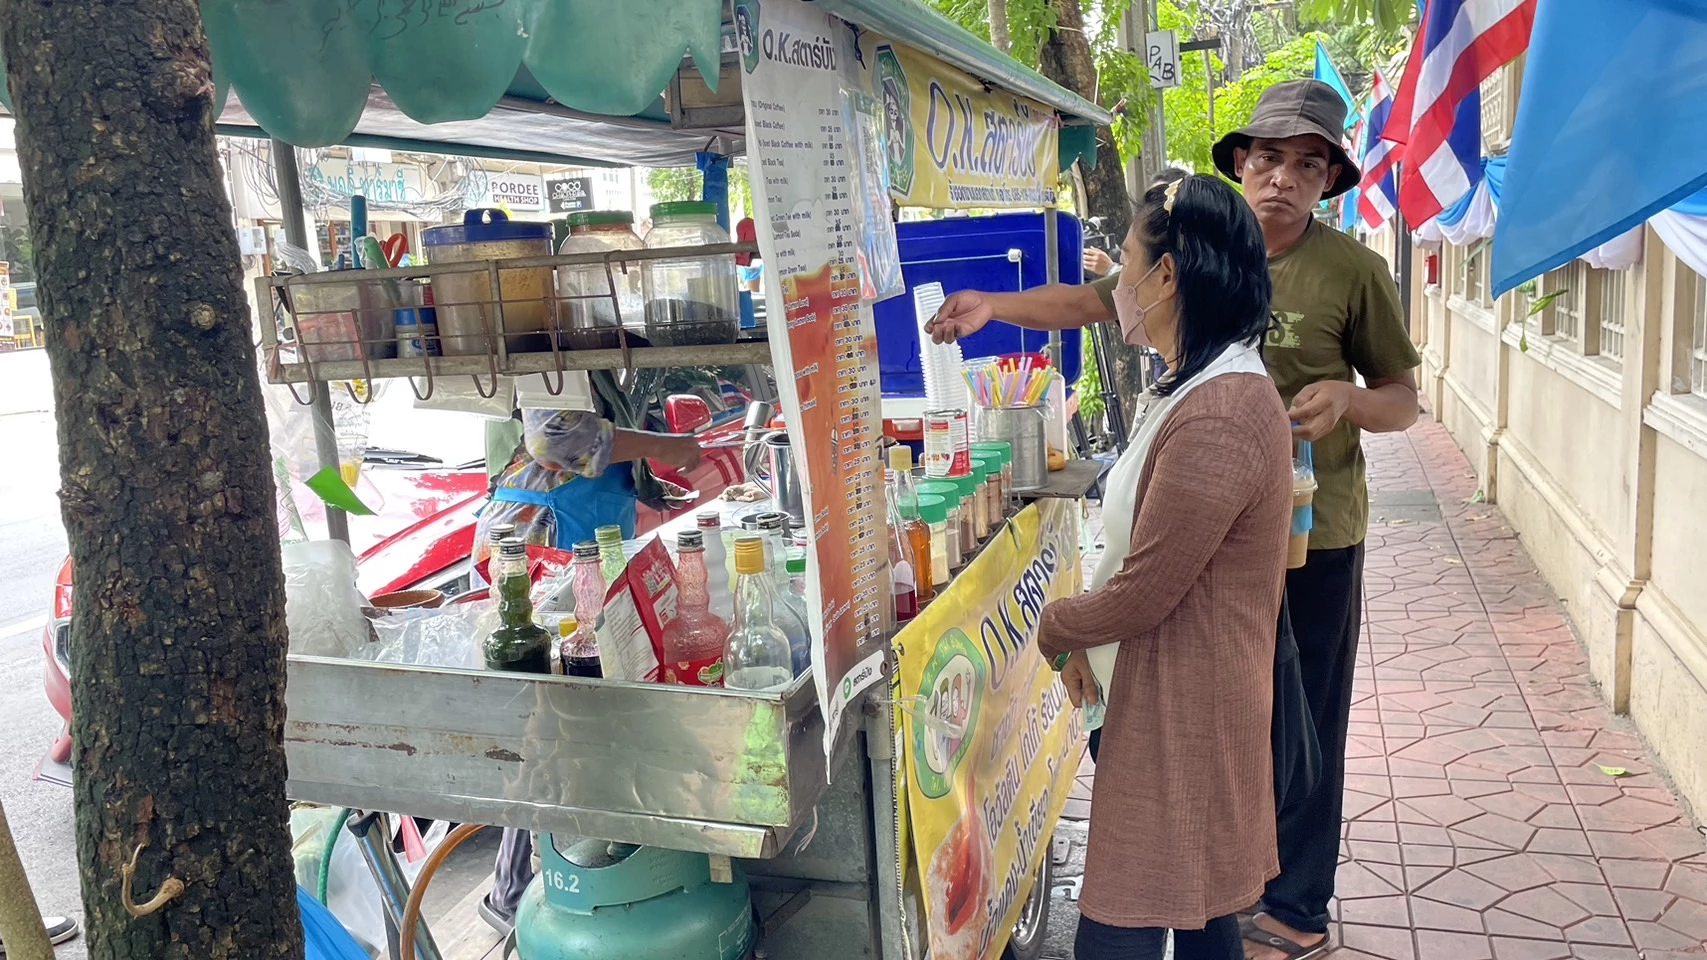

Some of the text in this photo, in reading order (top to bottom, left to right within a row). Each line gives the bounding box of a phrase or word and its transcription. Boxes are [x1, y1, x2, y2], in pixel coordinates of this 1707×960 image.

[491, 182, 539, 195] PORDEE
[984, 754, 1021, 849] โอวัลติน
[545, 868, 580, 893] 16.2
